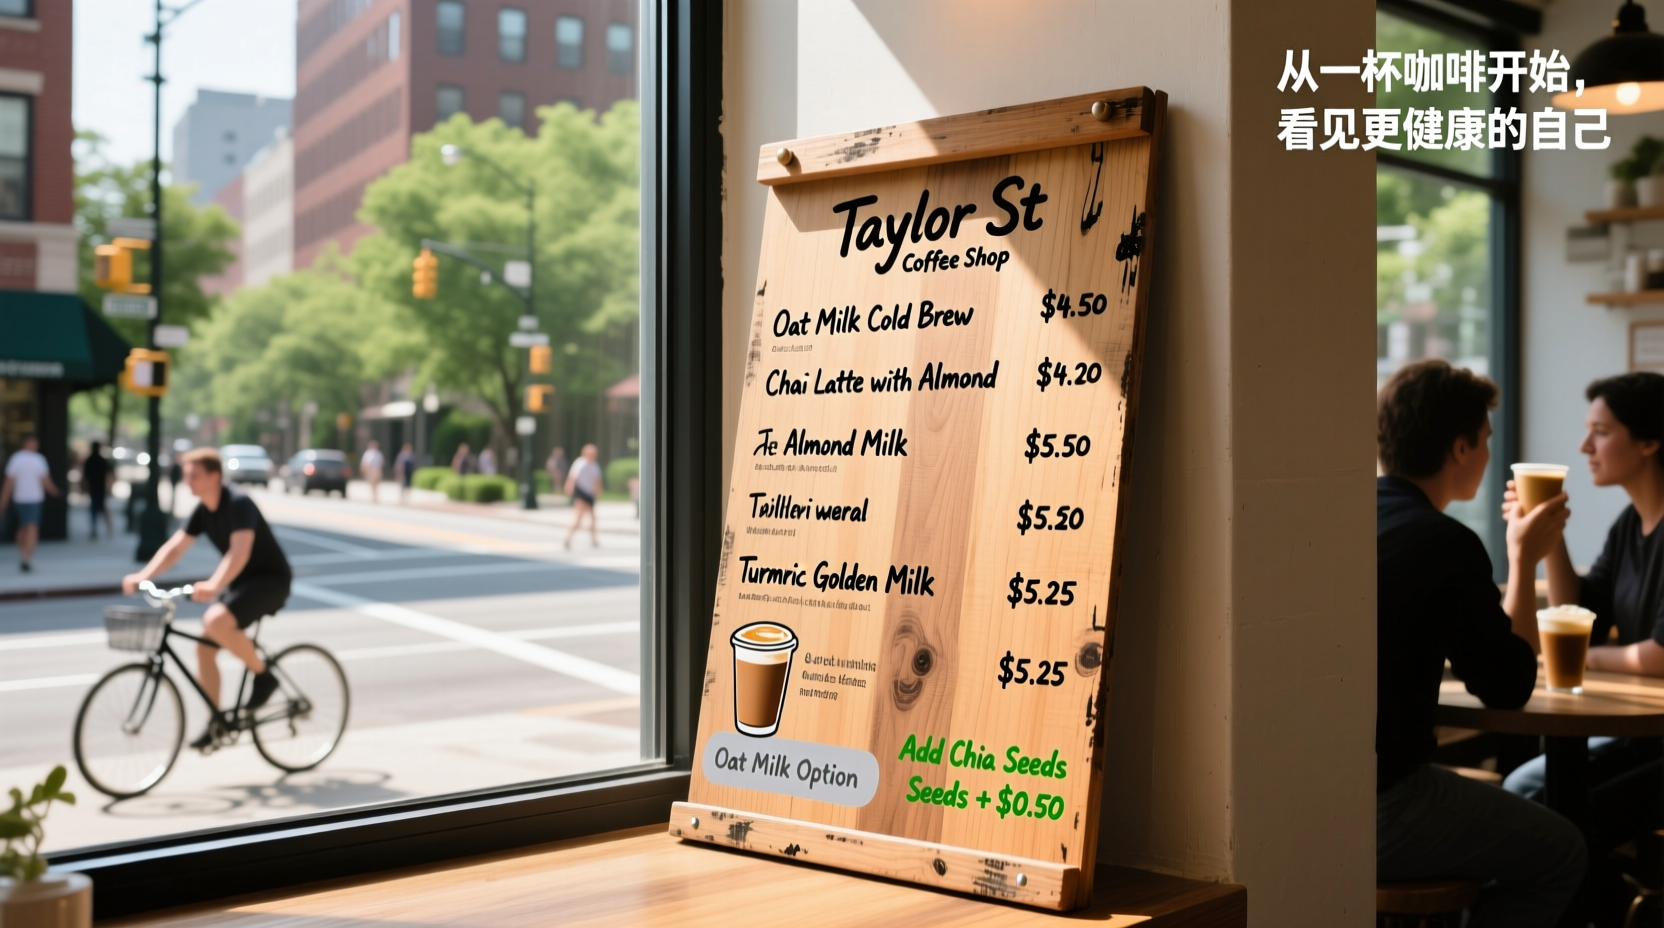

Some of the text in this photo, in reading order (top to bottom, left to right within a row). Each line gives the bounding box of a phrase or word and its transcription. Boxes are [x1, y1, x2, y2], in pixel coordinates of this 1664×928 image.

[832, 175, 1049, 275] Taylor St
[902, 246, 1010, 273] Coffee Shop
[773, 300, 974, 338] Oat Milk Cold Brew
[1040, 288, 1108, 324] $4.50
[765, 359, 1000, 397] Chai Latte with Almond
[1036, 356, 1102, 393] $4.20
[783, 428, 857, 457] Almond
[860, 428, 908, 457] Milk
[1024, 427, 1091, 465] $5.50
[1016, 499, 1085, 536] $5.20
[739, 555, 935, 597] Turmric Golden Milk
[1006, 571, 1077, 610] $5.25
[997, 650, 1069, 690] $5.25
[714, 746, 858, 790] Oat Milk Option
[898, 734, 1067, 780] Add Chia Seeds
[906, 775, 1065, 821] Seeds + $0.50
